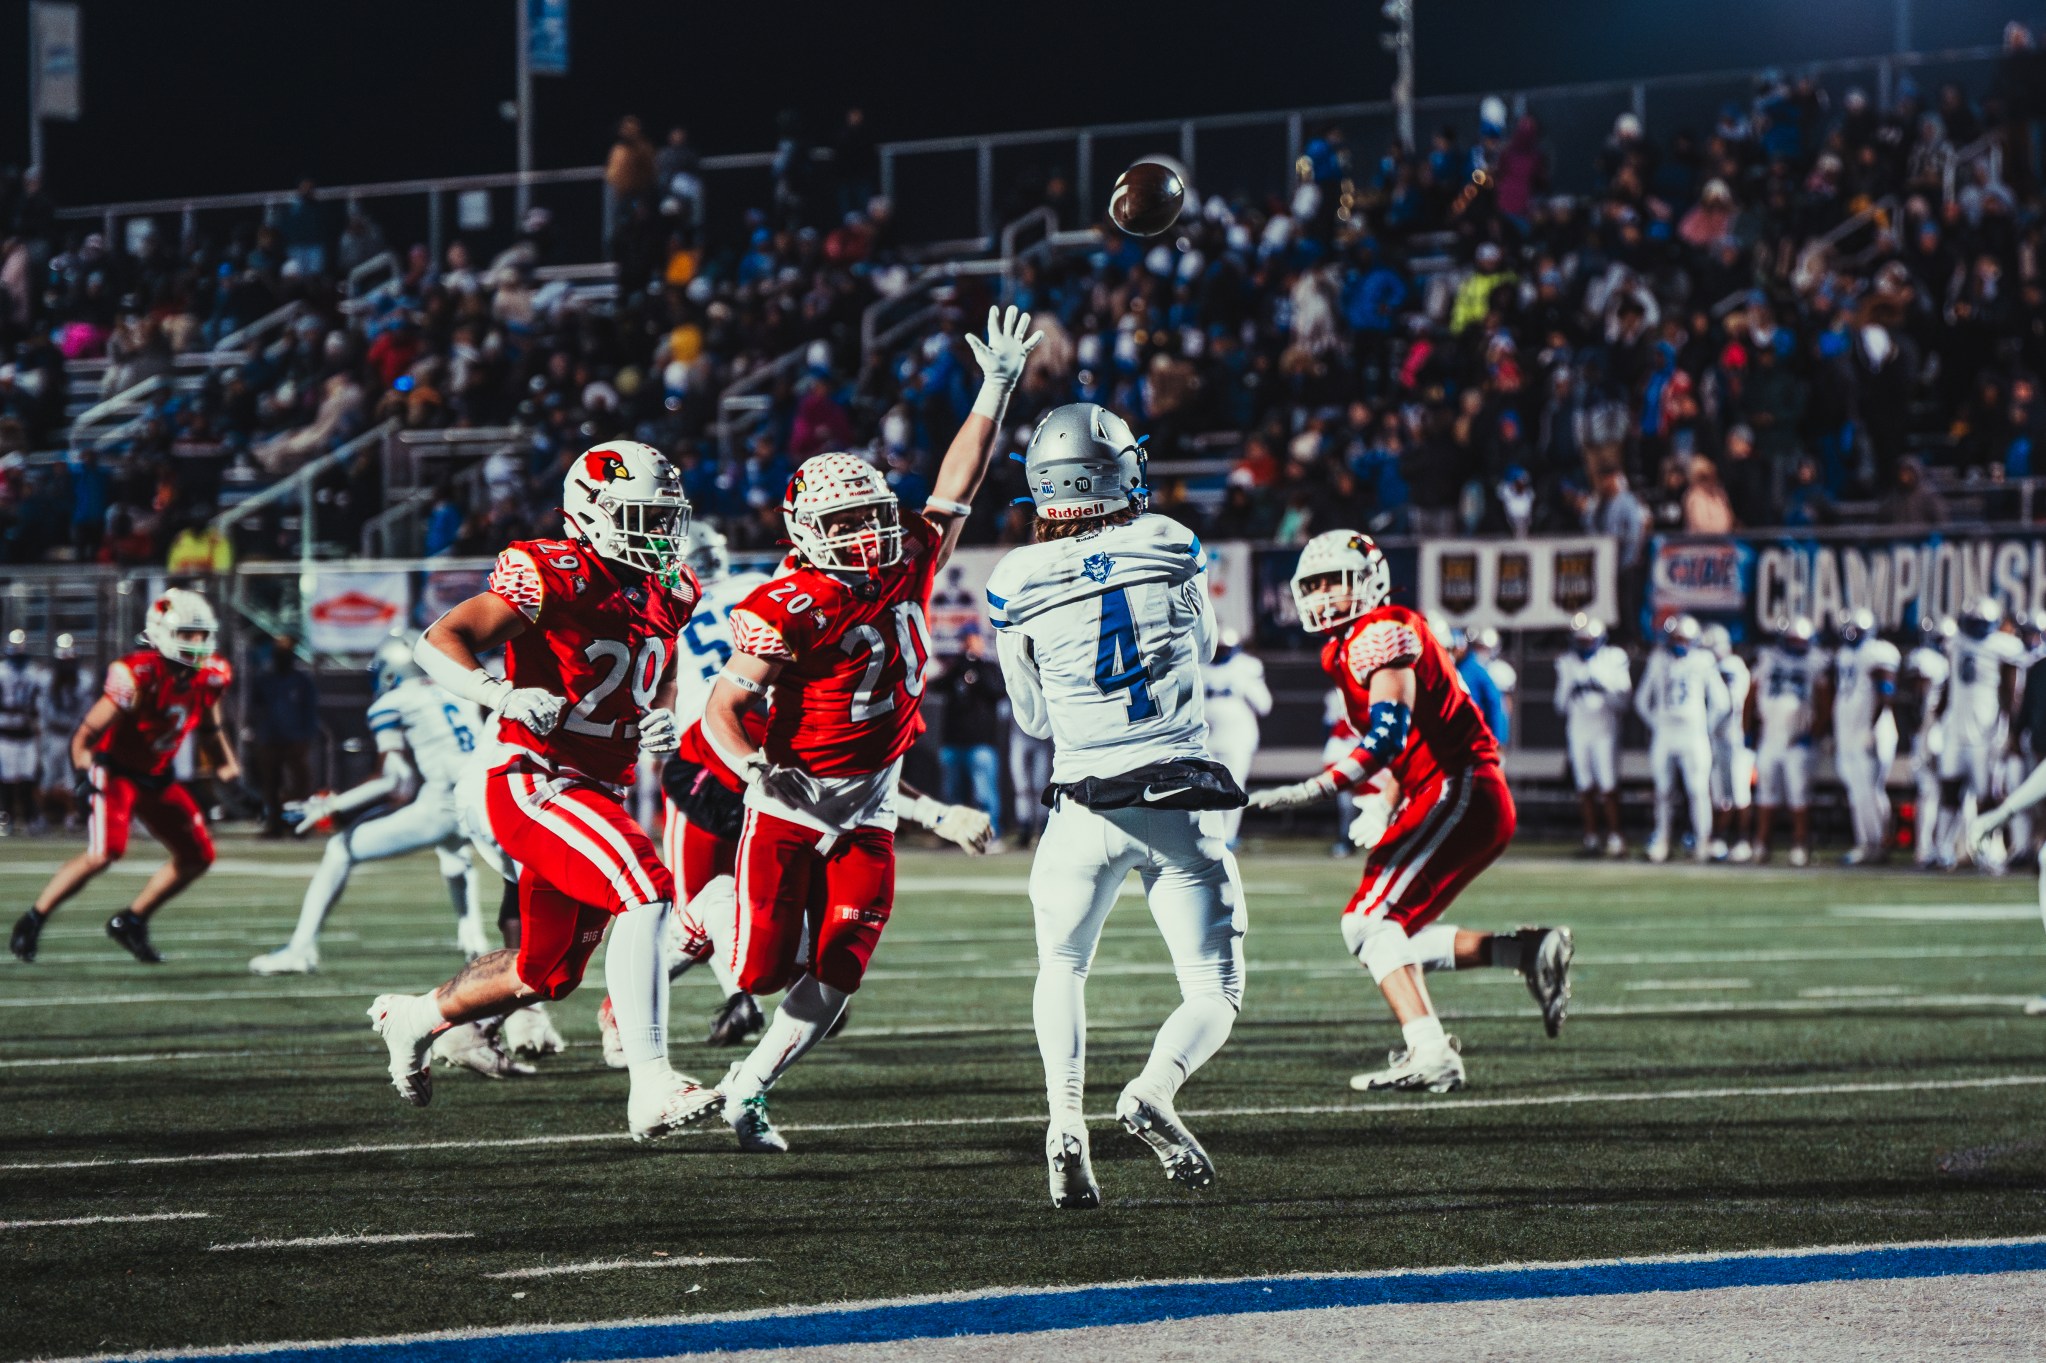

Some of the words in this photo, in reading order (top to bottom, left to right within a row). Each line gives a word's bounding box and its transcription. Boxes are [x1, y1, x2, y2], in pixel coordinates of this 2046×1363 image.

[1077, 479, 1089, 490] 70
[1047, 502, 1105, 520] Riddell
[1075, 533, 1099, 543] Riddell
[536, 543, 580, 571] 29
[767, 582, 814, 615] 20
[683, 604, 737, 679] 5
[1092, 587, 1163, 725] 4
[839, 600, 932, 723] 20
[563, 636, 667, 739] 29
[154, 704, 187, 751] 2
[842, 907, 859, 920] BIG
[581, 930, 599, 943] BIG
